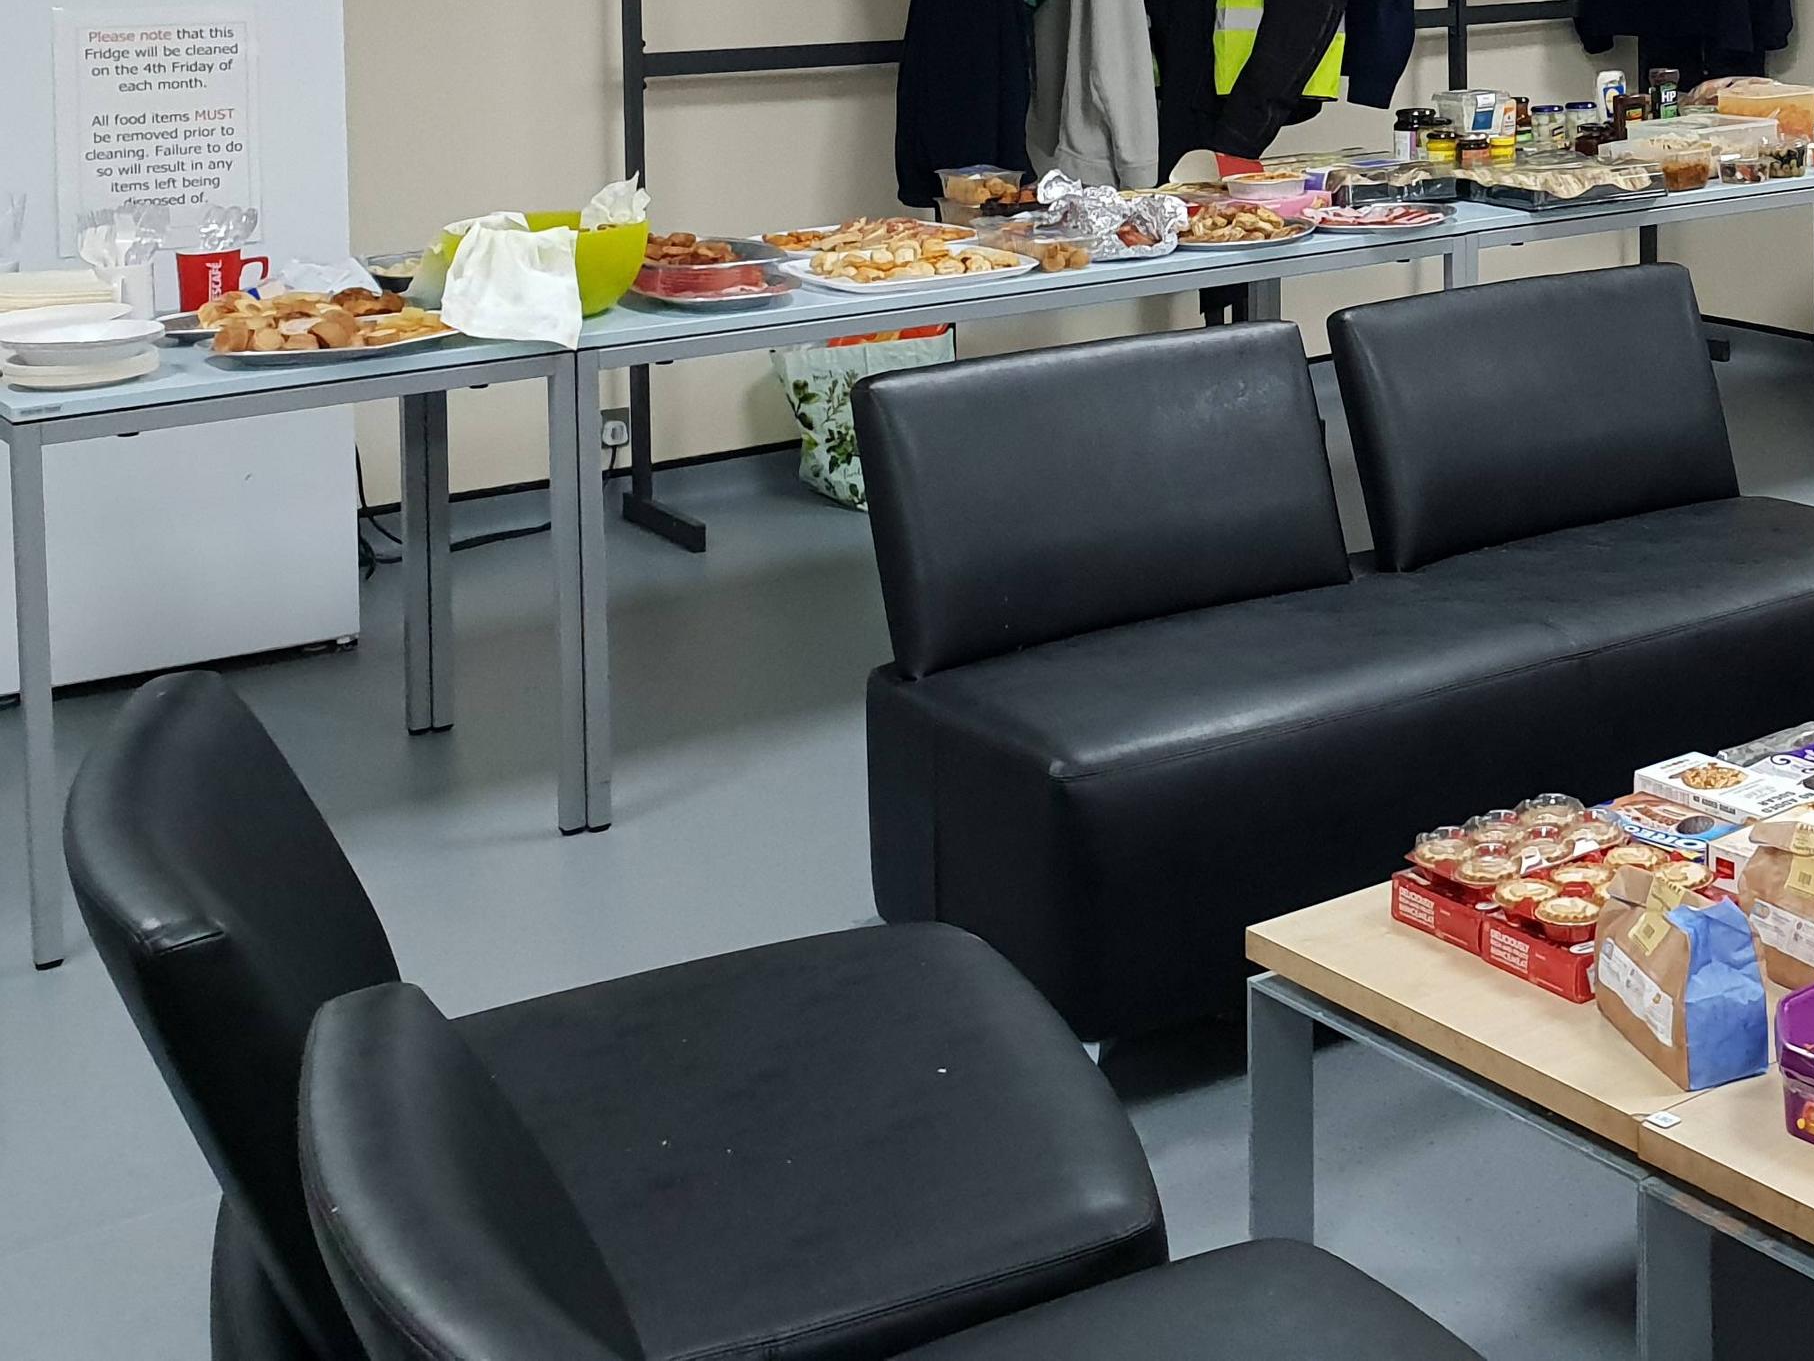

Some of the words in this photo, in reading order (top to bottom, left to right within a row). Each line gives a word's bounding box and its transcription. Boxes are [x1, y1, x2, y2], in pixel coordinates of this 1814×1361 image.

[88, 31, 135, 43] Please
[140, 30, 172, 41] note
[177, 28, 203, 40] that
[209, 26, 234, 39] this
[85, 48, 130, 61] Fridge
[135, 45, 158, 58] will
[164, 45, 181, 57] be
[185, 43, 238, 56] cleaned
[91, 66, 110, 76] on
[115, 64, 138, 75] the
[144, 63, 166, 74] 4th
[172, 61, 214, 73] Friday
[219, 59, 233, 71] of
[119, 80, 152, 92] each
[158, 78, 207, 90] month.
[1661, 90, 1677, 103] HP
[92, 115, 109, 127] All
[115, 113, 146, 125] food
[151, 111, 190, 124] items
[194, 108, 235, 121] MUST
[93, 132, 111, 144] be
[116, 128, 178, 142] removed
[184, 126, 216, 140] prior
[220, 126, 234, 136] to
[85, 148, 149, 161] cleaning.
[155, 144, 202, 157] Failure
[206, 143, 221, 154] to
[226, 141, 243, 153] do
[96, 166, 113, 177] so
[118, 163, 141, 175] will
[146, 161, 185, 174] result
[191, 159, 203, 170] in
[208, 160, 233, 171] any
[111, 180, 150, 192] items
[155, 177, 177, 189] left
[183, 176, 220, 189] being
[190, 192, 208, 204] of.
[1623, 824, 1707, 851] OREO
